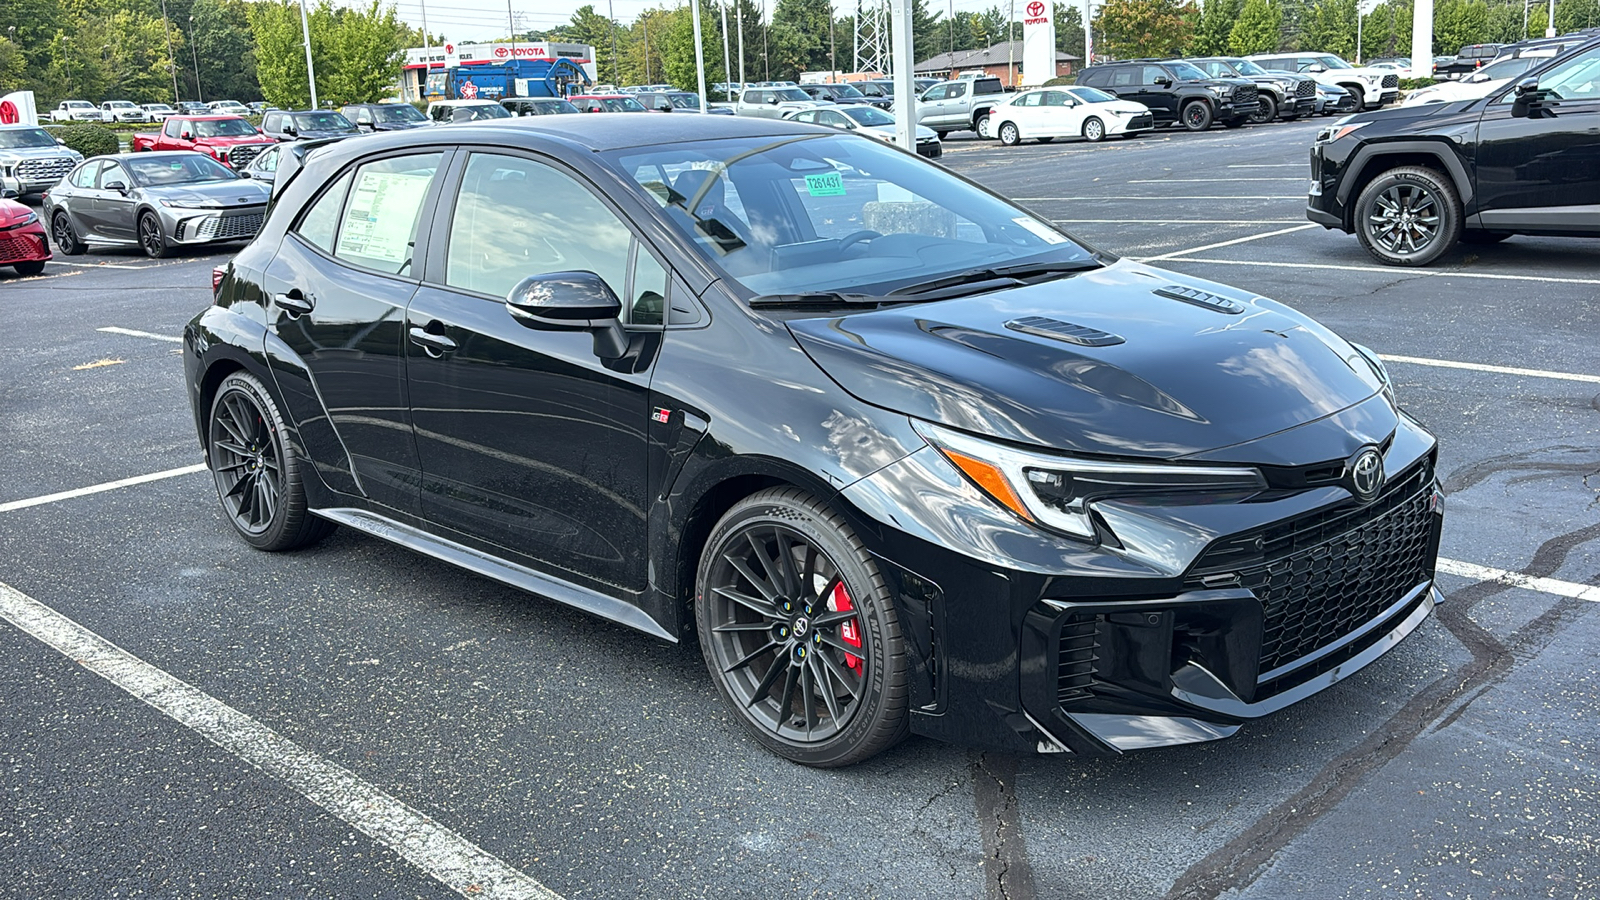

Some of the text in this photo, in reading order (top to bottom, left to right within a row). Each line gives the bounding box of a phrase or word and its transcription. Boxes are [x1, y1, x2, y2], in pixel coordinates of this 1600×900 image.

[1024, 17, 1048, 25] TOYOTA
[509, 48, 545, 56] TOYOTA
[807, 176, 840, 189] T261431
[1406, 174, 1437, 189] MICHELIN
[232, 380, 255, 394] MICHELIN
[652, 411, 669, 423] GR
[870, 618, 883, 693] MICHELIN
[861, 701, 876, 728] 235/40
